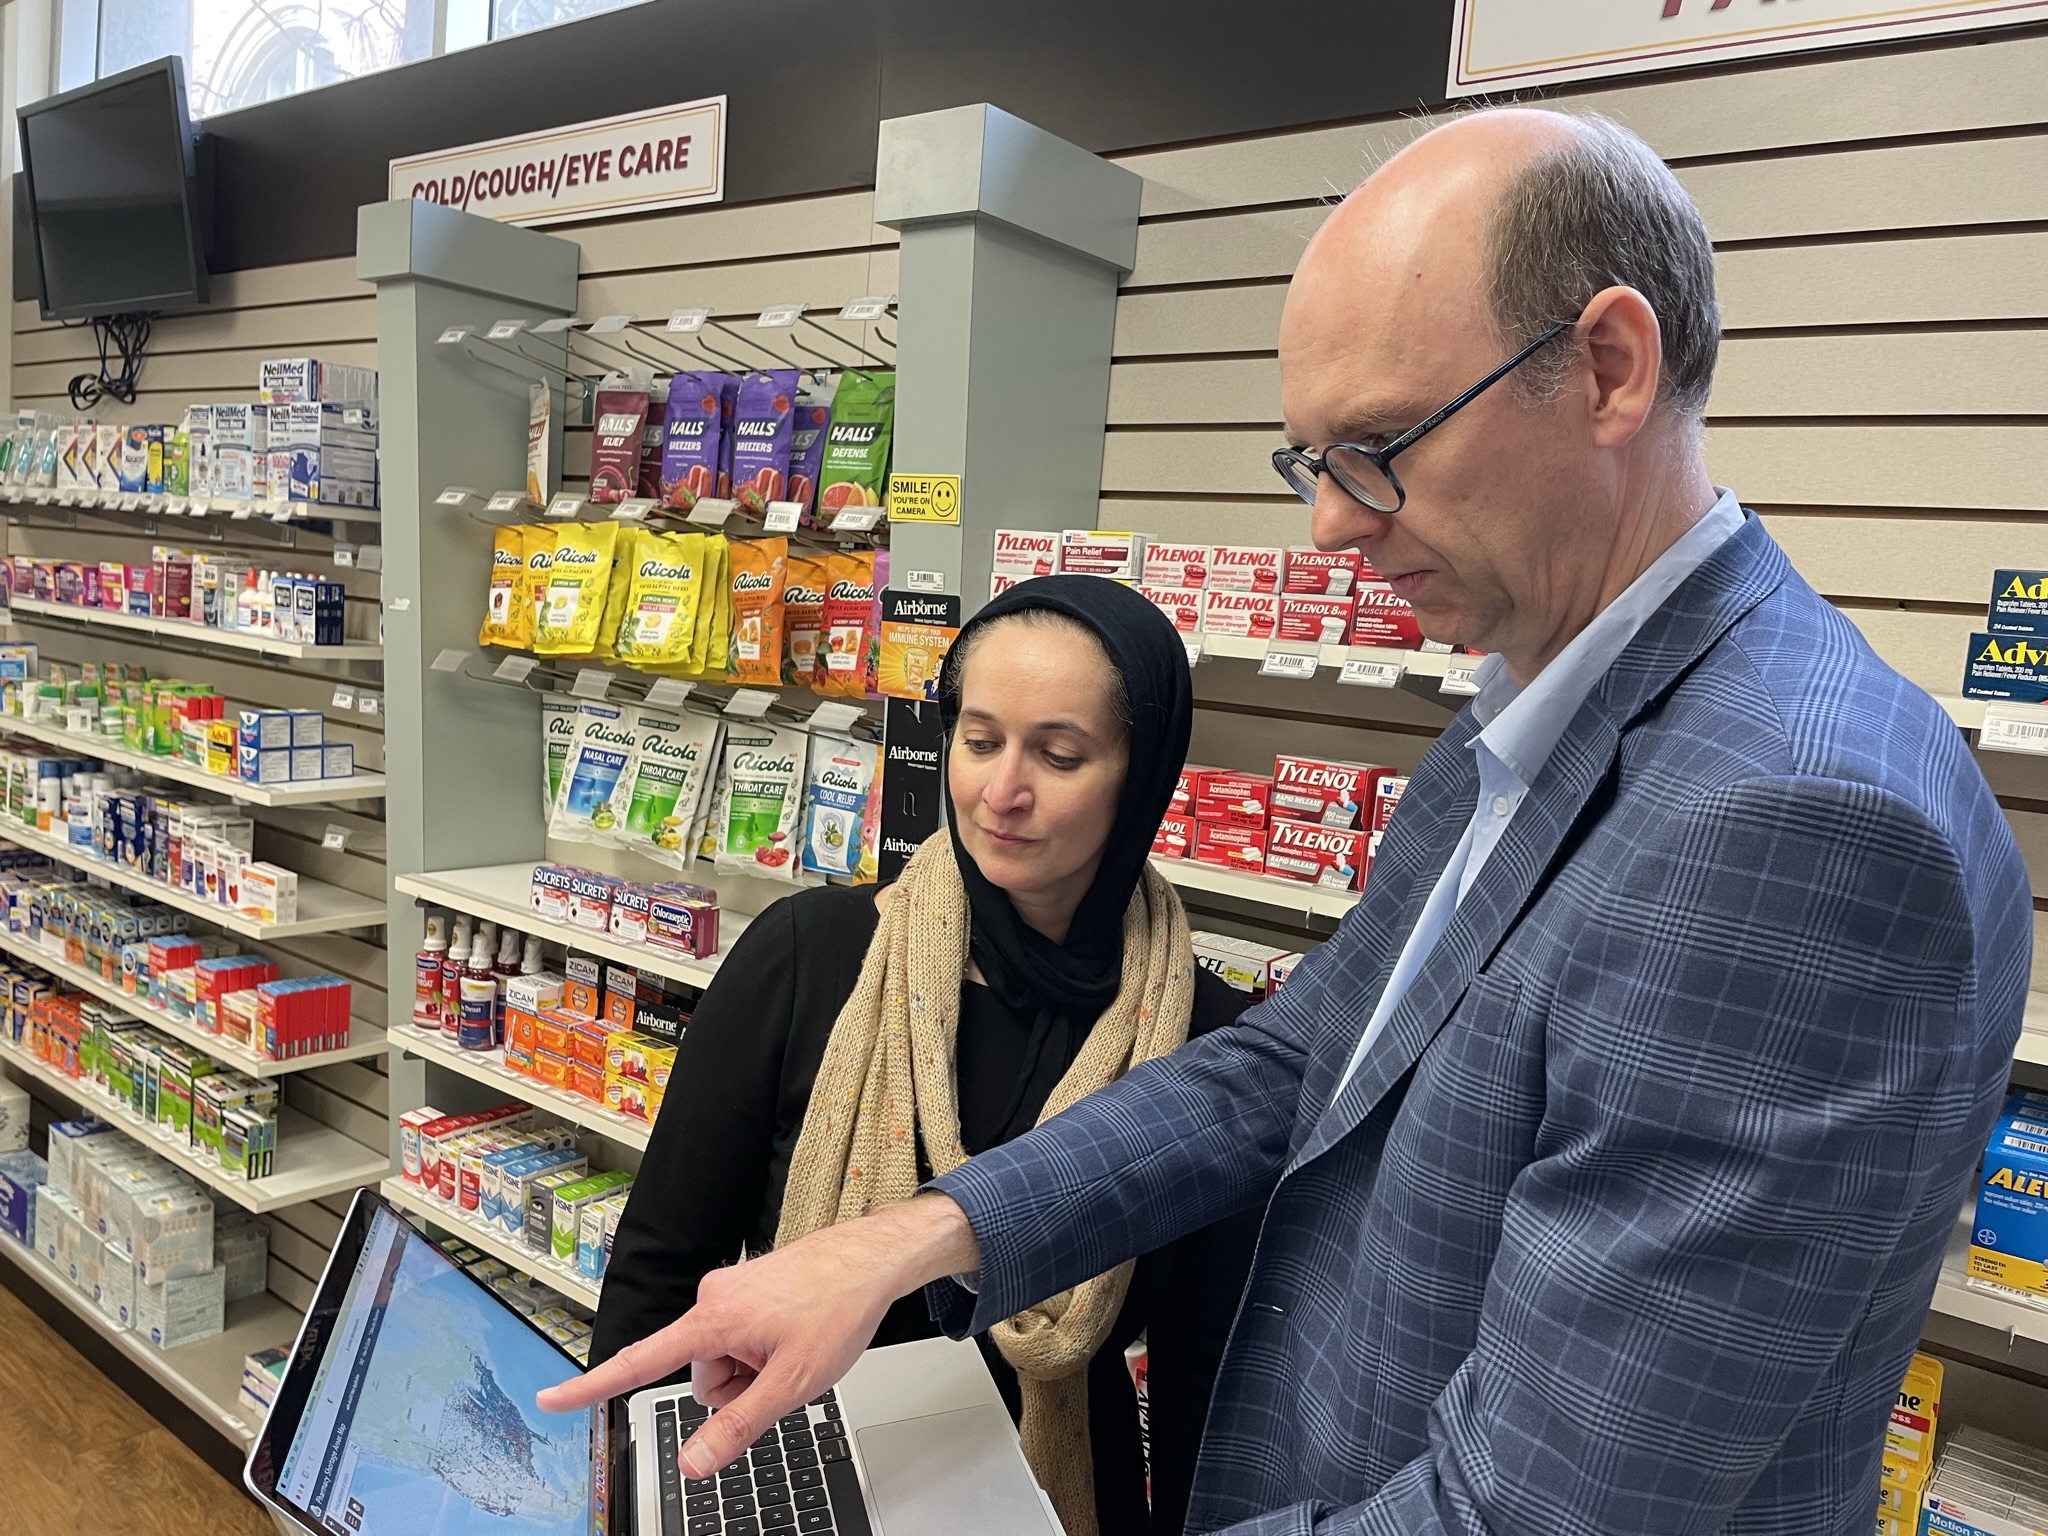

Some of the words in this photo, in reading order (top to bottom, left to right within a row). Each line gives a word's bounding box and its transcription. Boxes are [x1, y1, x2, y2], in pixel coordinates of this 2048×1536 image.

[618, 136, 692, 178] CARE
[264, 362, 304, 375] NeilMed
[216, 406, 246, 418] NeilMed
[600, 418, 634, 432] HALLS
[670, 421, 704, 436] HALLS
[737, 421, 776, 437] HALLS
[831, 426, 875, 442] HALLS
[832, 448, 869, 458] DEFENSE
[892, 481, 930, 493] SMILE!
[896, 507, 926, 515] CAMERA
[997, 533, 1054, 552] TYLENOL
[555, 548, 597, 563] Ricola
[1065, 547, 1080, 555] Pain
[1082, 547, 1102, 556] Relief
[1147, 545, 1207, 563] TYLENOL
[1213, 548, 1277, 567] TYLENOL
[1290, 553, 1336, 566] TYLENOL
[640, 560, 691, 579] Ricola
[734, 572, 771, 590] Ricola
[784, 588, 824, 603] Rico
[830, 582, 873, 598] Ricol
[1138, 588, 1198, 607] TYLENOL
[894, 600, 947, 615] Airborne
[1207, 592, 1274, 612] TYLENOL
[1283, 600, 1329, 615] TYLENOL
[1358, 608, 1389, 616] MUSCLE
[889, 632, 918, 645] IMMUNE
[920, 634, 950, 648] SYSTEM
[550, 717, 574, 735] Ric
[585, 722, 635, 746] Ricola
[642, 734, 697, 761] Ricola
[888, 745, 938, 762] Airborne
[584, 749, 605, 762] NASAL
[607, 753, 623, 766] CARE
[734, 752, 794, 773] Ricola
[642, 764, 665, 776] THROAT
[667, 770, 684, 781] CARE
[823, 771, 857, 790] Ricola
[1278, 760, 1358, 791] TYLENOL
[734, 782, 762, 793] THROAT
[764, 785, 784, 795] CARE
[1210, 785, 1251, 796] Acetaminophen
[820, 790, 835, 802] COOL
[837, 793, 856, 806] RELIEF
[1276, 794, 1294, 802] RAPID
[1294, 797, 1321, 807] RELEASE
[1210, 831, 1250, 843] Acetaminophen
[1272, 822, 1354, 856] TYLENOL
[1271, 856, 1288, 865] RAPID
[1289, 860, 1317, 870] RELEASE
[534, 868, 570, 889] SUCRETS
[571, 879, 607, 900] SUCRETS
[614, 889, 649, 911] SUCRETS
[652, 906, 690, 925] Chloraseptic
[569, 961, 596, 977] ZICAM
[608, 972, 634, 990] ZICAM
[509, 989, 534, 1005] ZICAM
[636, 1010, 677, 1032] Airborne
[482, 1160, 499, 1178] VISINE
[503, 1172, 520, 1189] VISINE
[555, 1196, 573, 1214] VISINE
[1975, 1255, 2006, 1267] STRENGTH
[1981, 1268, 2003, 1278] HOURS
[337, 1423, 347, 1435] Map
[333, 1435, 342, 1452] Areas
[324, 1450, 338, 1476] Shortage
[316, 1476, 331, 1505] Pharmacy
[1930, 1514, 1970, 1536] Motion
